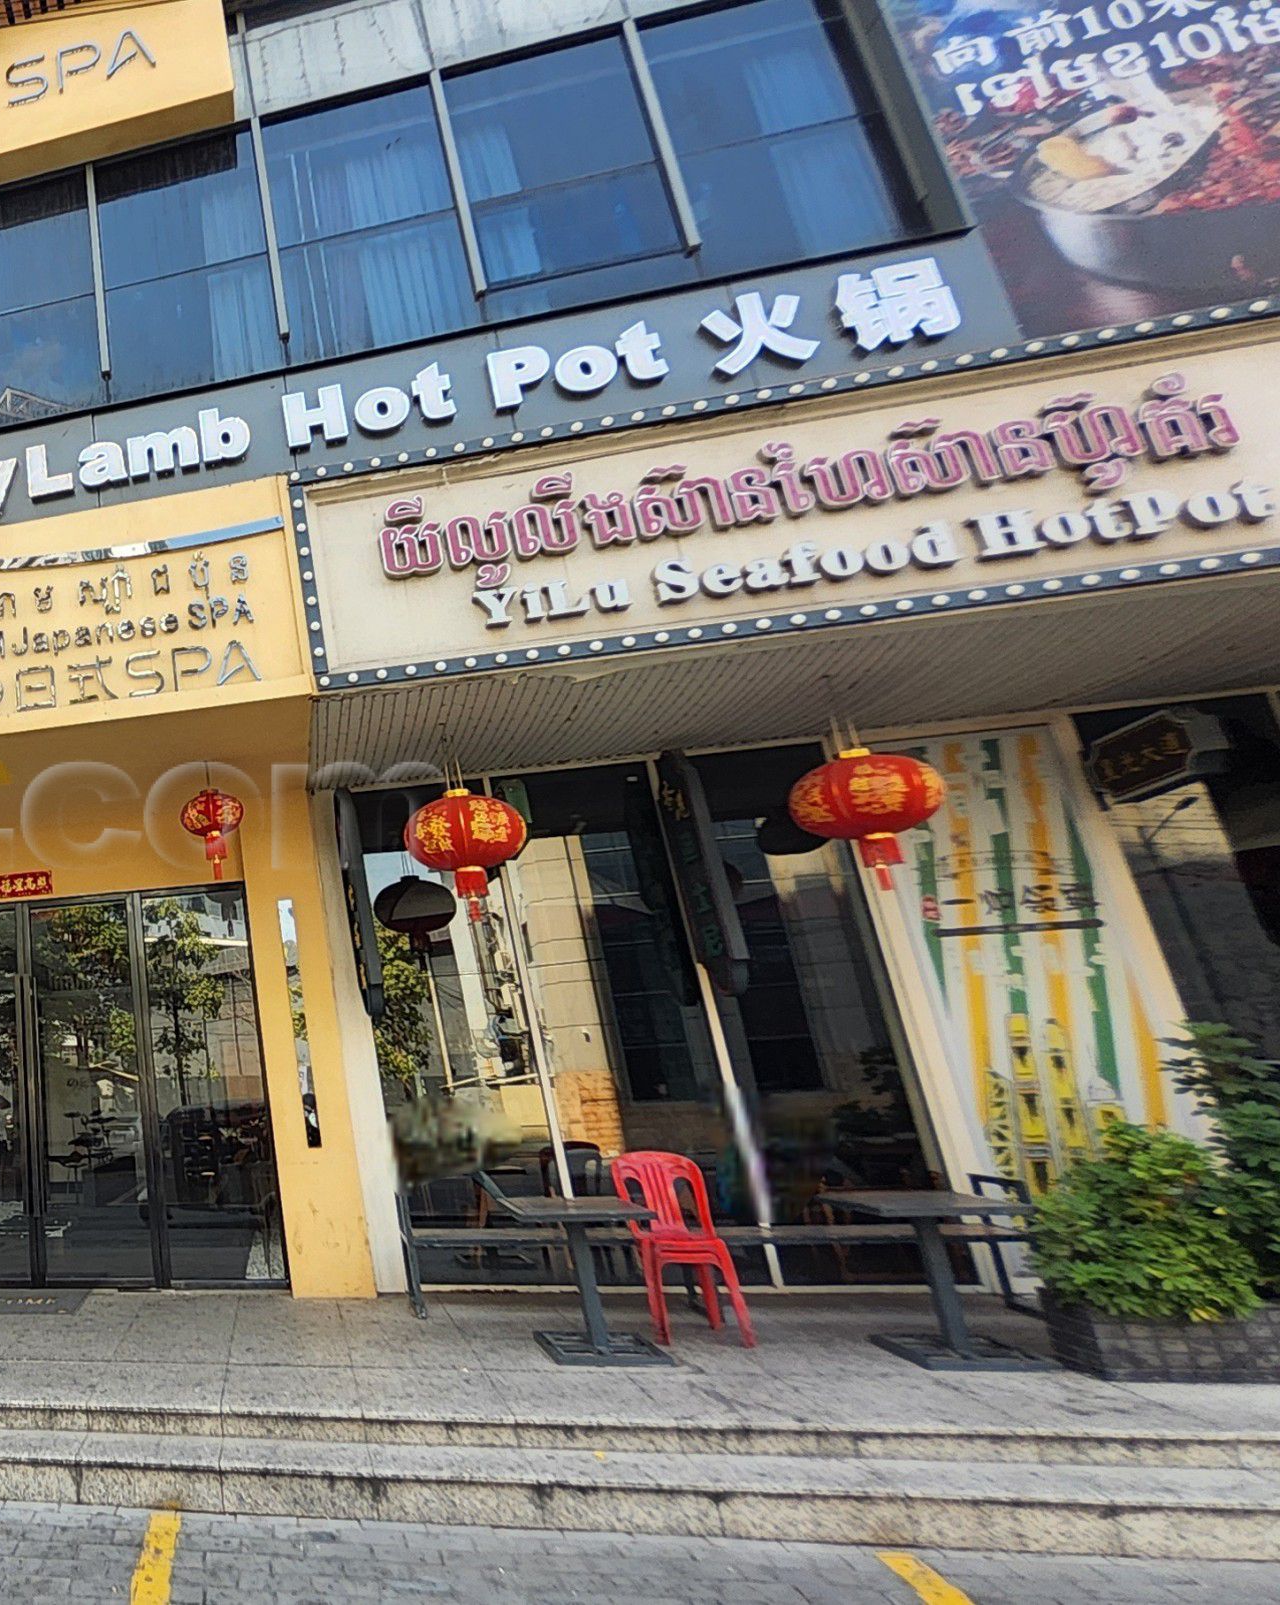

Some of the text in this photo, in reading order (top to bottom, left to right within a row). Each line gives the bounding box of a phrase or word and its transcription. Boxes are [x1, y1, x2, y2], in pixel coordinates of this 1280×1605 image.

[282, 361, 457, 449] Hot
[486, 320, 670, 411] Pot
[473, 476, 1276, 629] YiLu Seafood HotPot
[11, 611, 179, 657] Japanese
[188, 593, 254, 630] SPA
